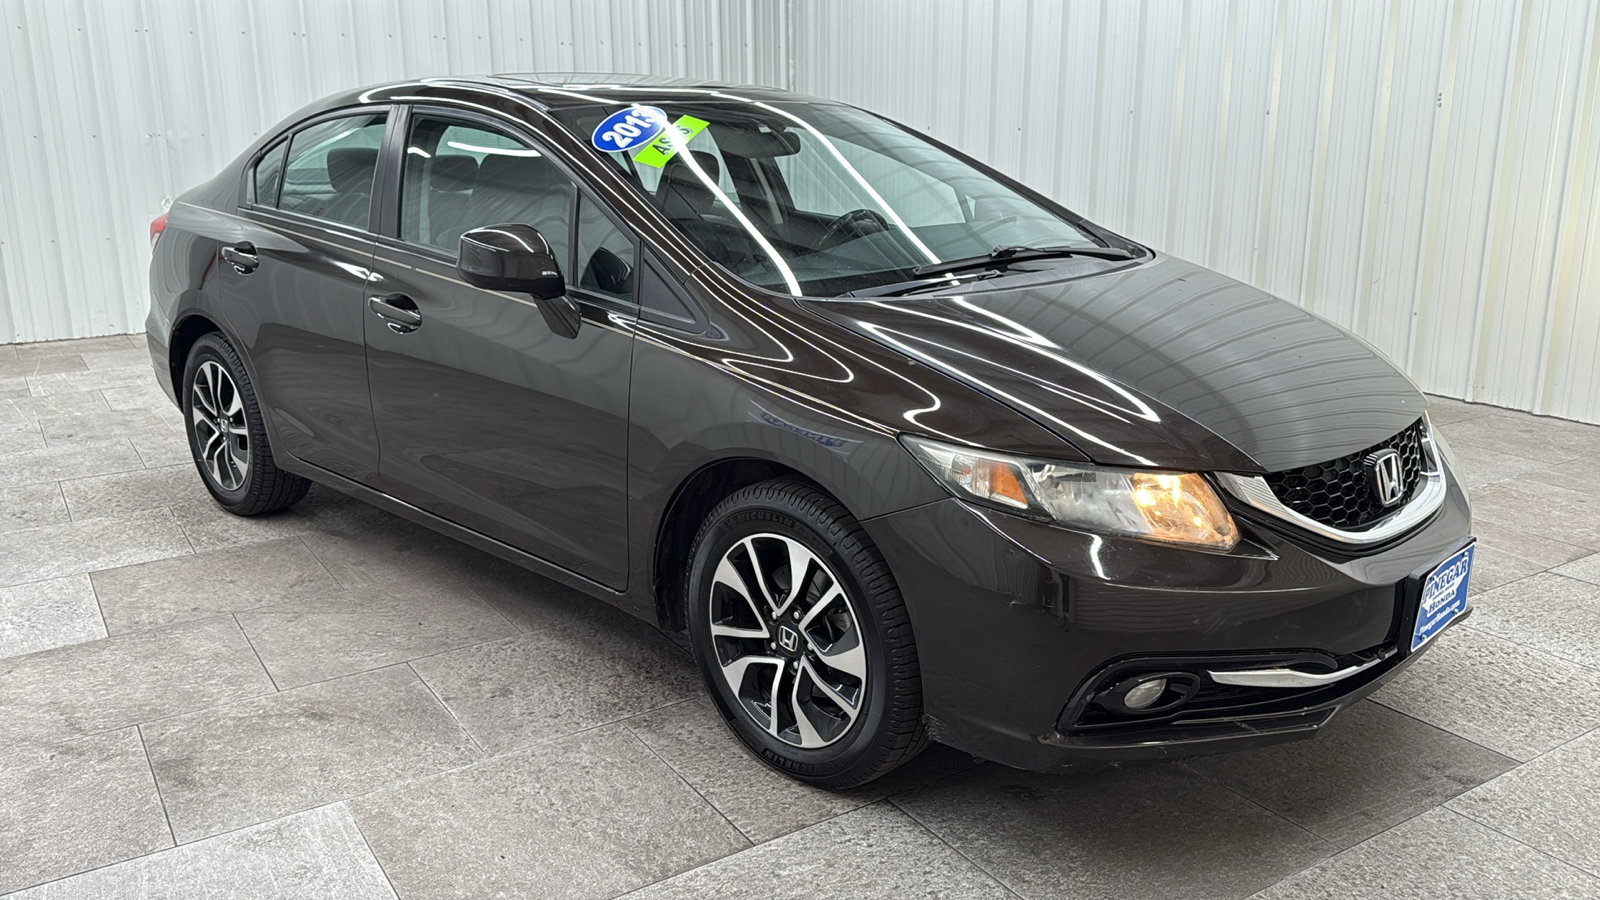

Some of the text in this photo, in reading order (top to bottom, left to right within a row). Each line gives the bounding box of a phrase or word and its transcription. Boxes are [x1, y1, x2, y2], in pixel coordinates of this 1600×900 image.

[602, 110, 658, 148] 2013
[738, 511, 793, 528] MICHELIN
[1424, 560, 1467, 603] PINEGAR
[1430, 590, 1455, 613] HONDA
[764, 749, 823, 773] MICHELIN
